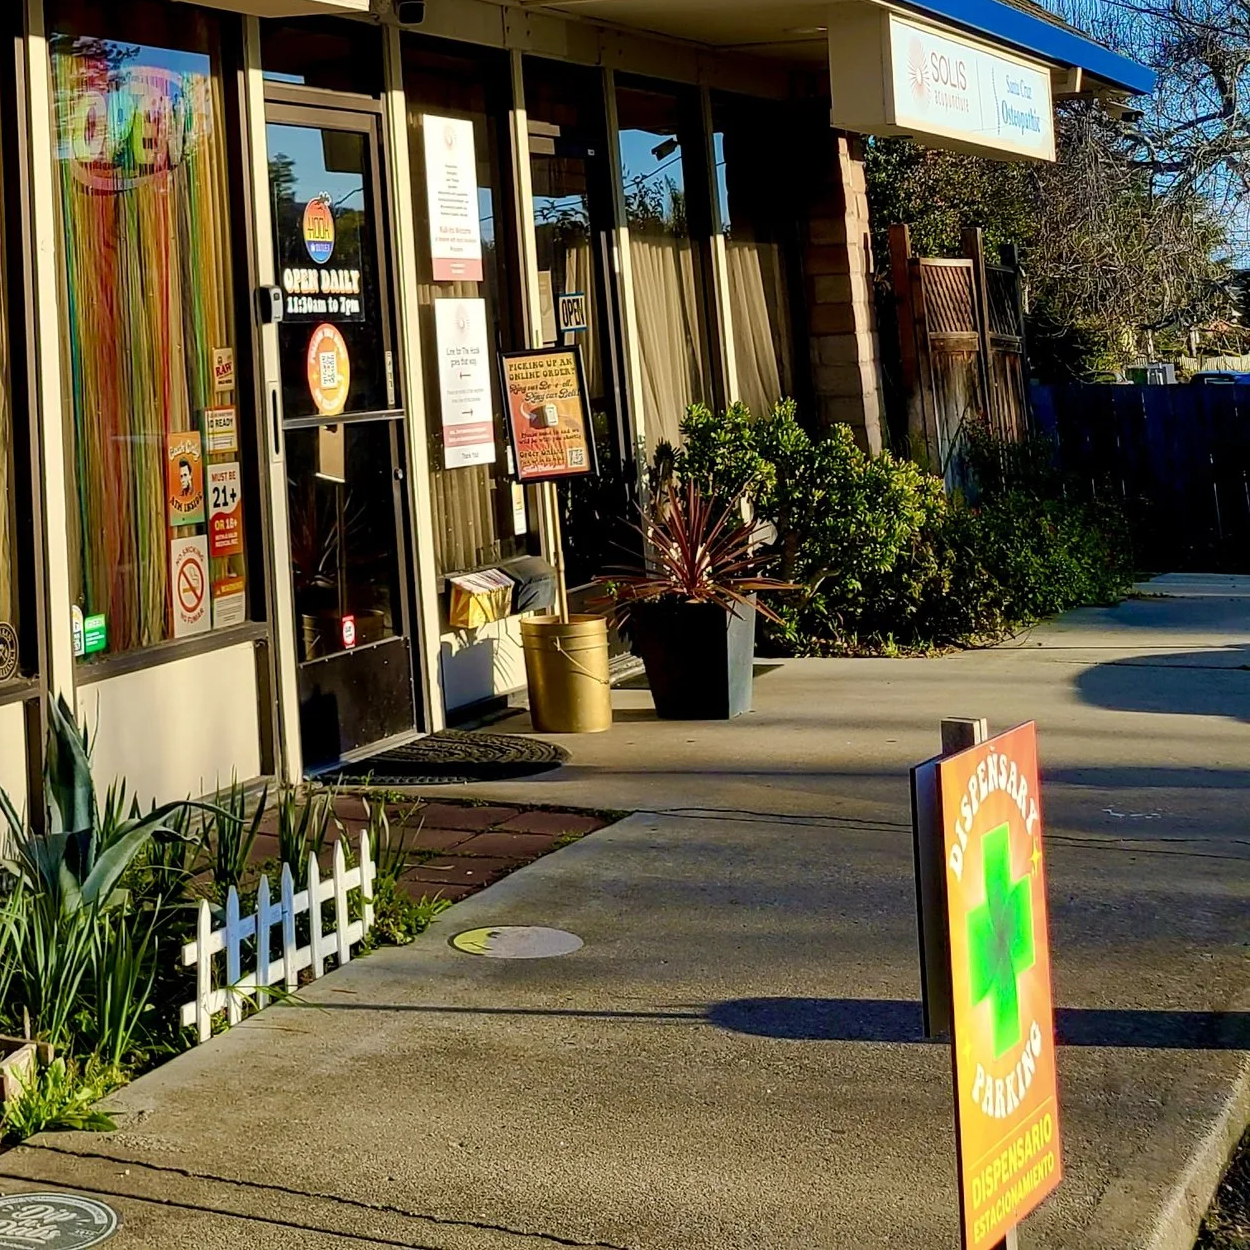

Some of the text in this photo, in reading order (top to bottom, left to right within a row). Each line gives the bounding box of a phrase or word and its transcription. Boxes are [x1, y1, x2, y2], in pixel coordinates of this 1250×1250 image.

[930, 51, 967, 90] SOLIS
[1005, 74, 1033, 100] Santa Cruz
[283, 268, 360, 294] OPEN DAILY
[287, 296, 360, 316] 11:30am to 7pm
[561, 297, 584, 327] OPEN
[215, 361, 232, 377] RAW
[509, 358, 572, 371] PICKING UP AN
[509, 367, 575, 381] ONLINE ORDER?
[215, 417, 233, 428] READY
[211, 470, 236, 483] MUST BE
[170, 491, 203, 513] ATM INSIDE
[212, 485, 237, 508] 21+
[214, 518, 238, 530] OR 18+
[175, 545, 204, 566] NO SMOKING
[180, 611, 187, 623] NO
[949, 752, 1039, 883] DISPENSARY
[971, 1019, 1042, 1118] PARKING
[971, 1112, 1053, 1211] DISPENSARIO
[973, 1152, 1055, 1244] ESTACIONAMIENTO
